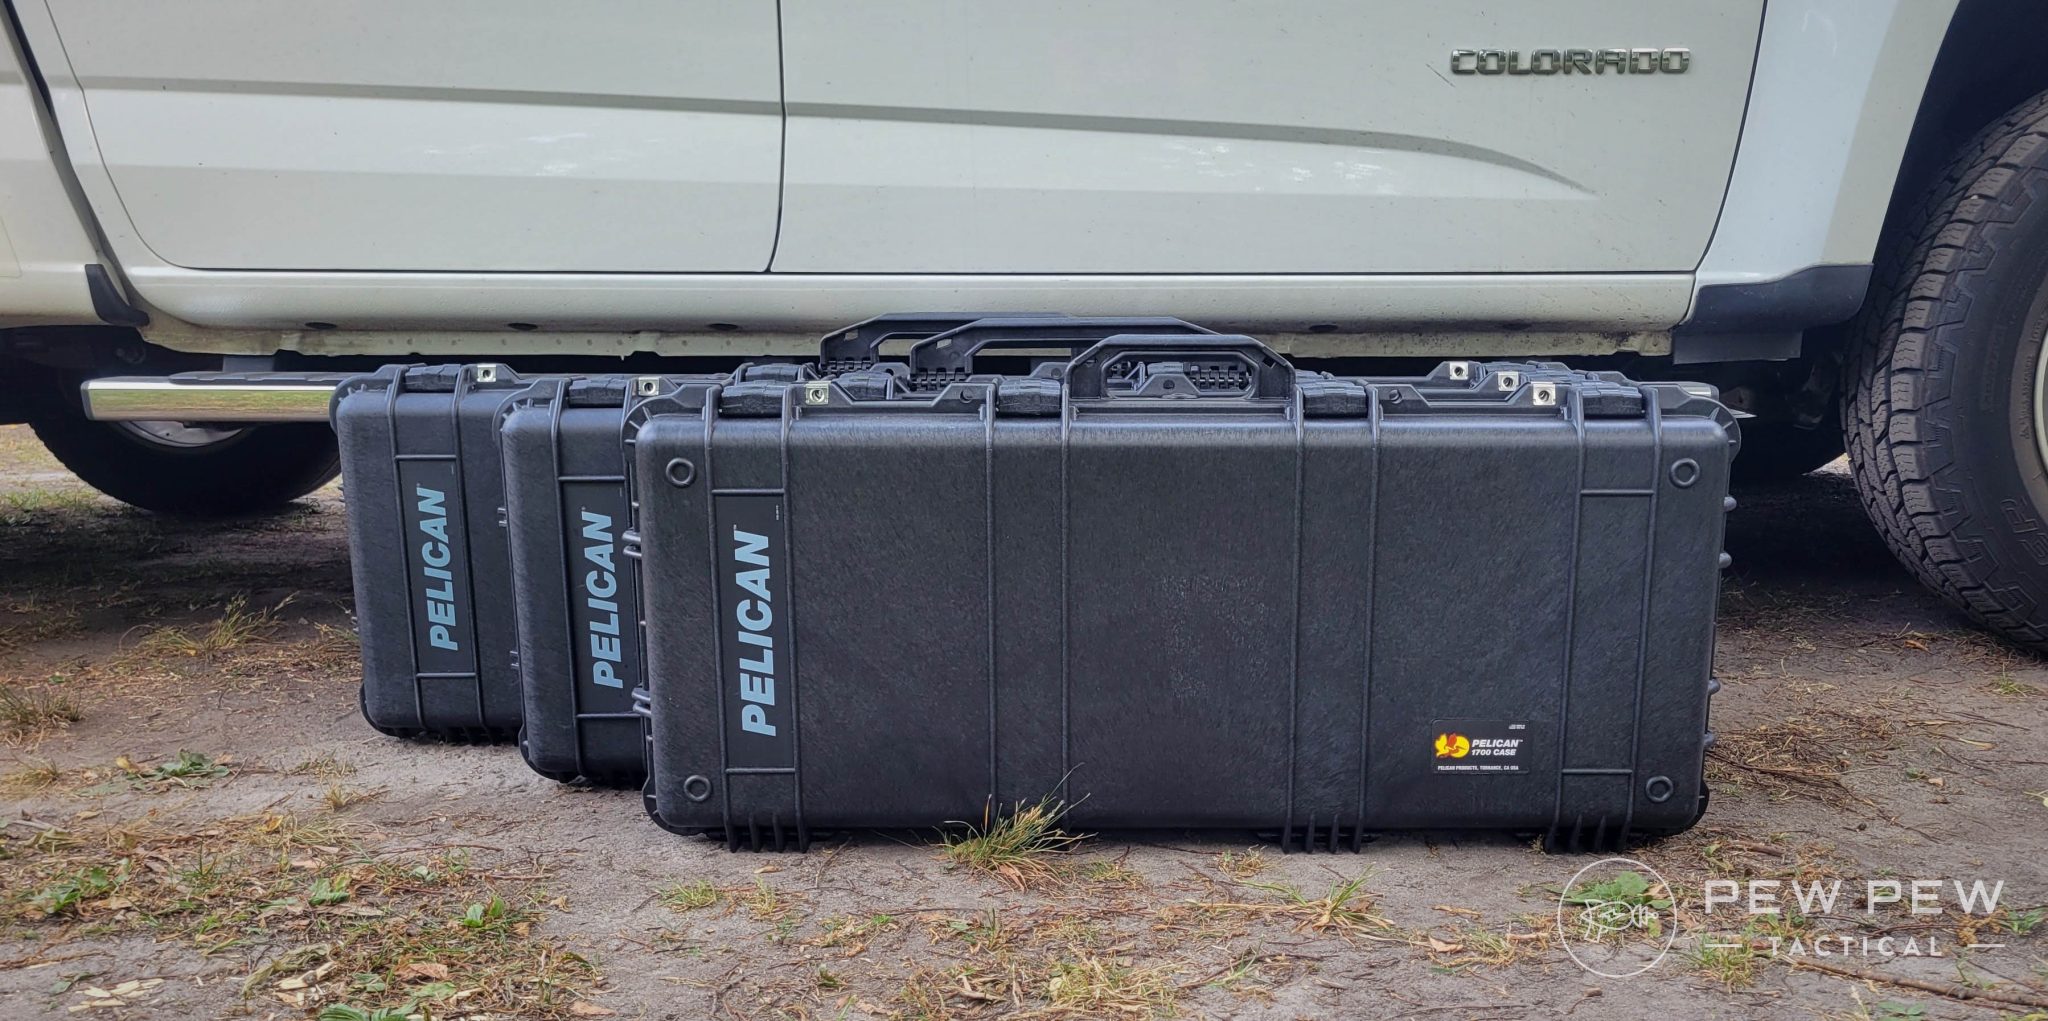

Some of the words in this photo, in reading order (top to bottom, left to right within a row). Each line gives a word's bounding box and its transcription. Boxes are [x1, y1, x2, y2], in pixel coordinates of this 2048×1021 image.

[1451, 48, 1691, 75] COLORADO
[416, 486, 459, 651] PELICAN
[581, 511, 624, 689] PELICAN
[733, 529, 777, 737] PELICAN
[1472, 739, 1519, 748] PELICAN
